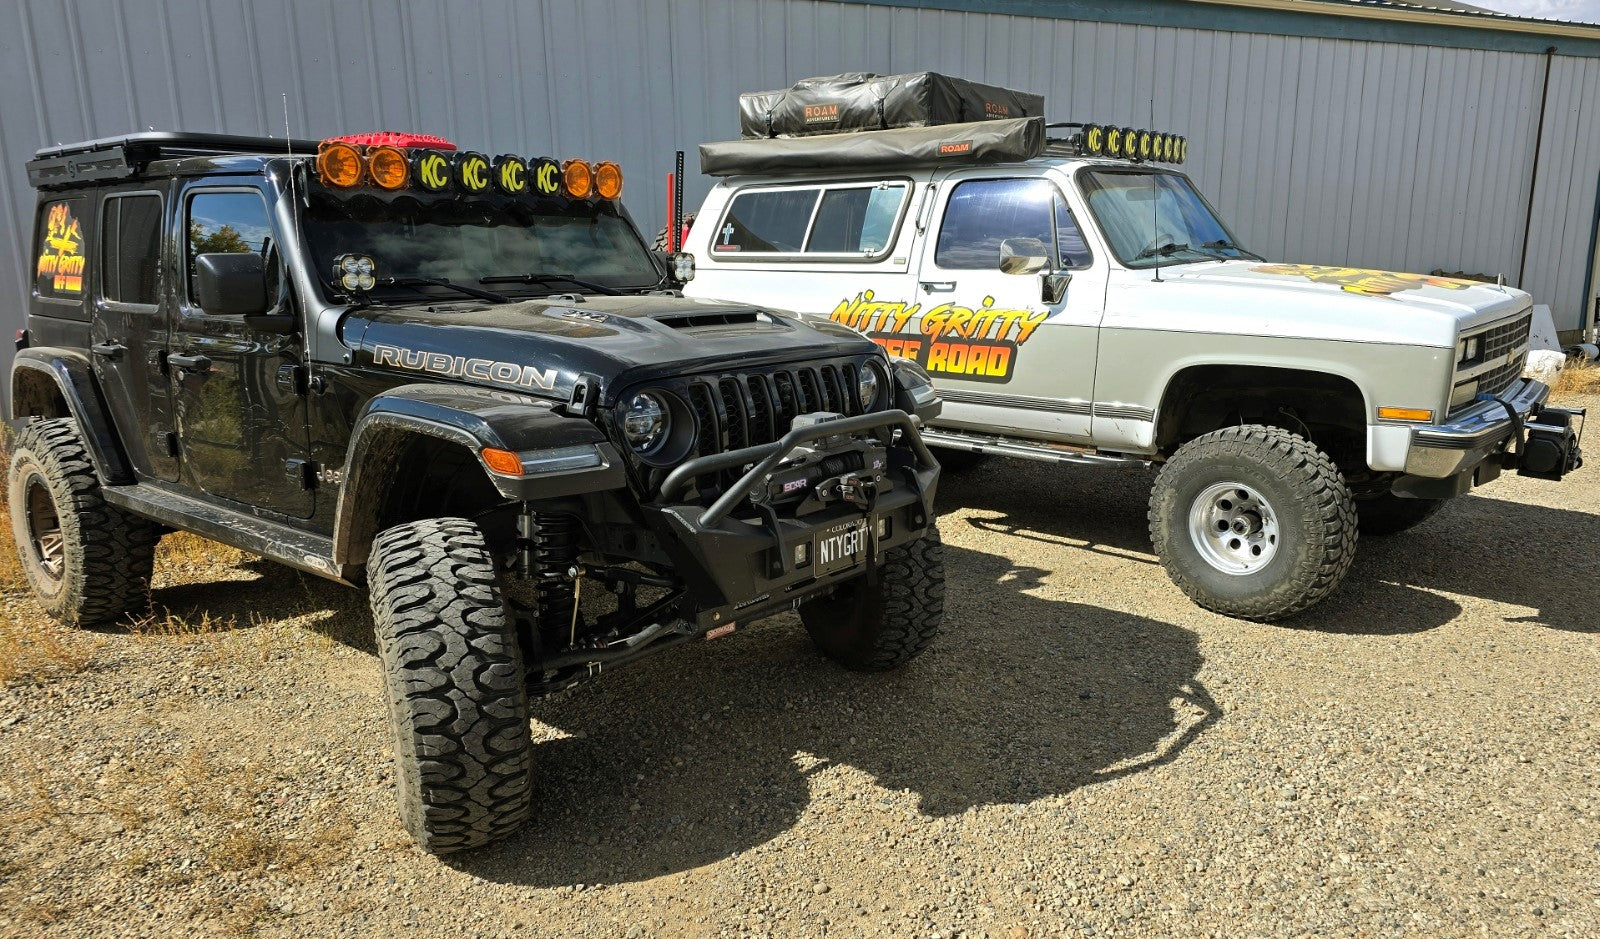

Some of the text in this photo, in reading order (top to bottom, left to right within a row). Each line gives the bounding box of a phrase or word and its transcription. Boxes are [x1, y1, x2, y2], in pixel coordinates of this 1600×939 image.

[805, 105, 838, 117] ROAM
[985, 102, 1009, 115] ROAM
[941, 143, 969, 153] ROAM
[1088, 127, 1102, 151] KC
[1108, 129, 1120, 153] KC
[1125, 131, 1136, 155] KC
[1140, 133, 1150, 156] KC
[1153, 135, 1162, 157] KC
[421, 155, 447, 188] KC
[463, 158, 487, 190] KC
[501, 161, 524, 191] KC
[537, 163, 558, 193] KC
[373, 345, 558, 390] RUBICON
[872, 338, 1011, 377] FF ROAD
[316, 463, 343, 485] Jee
[784, 479, 807, 492] SCAR
